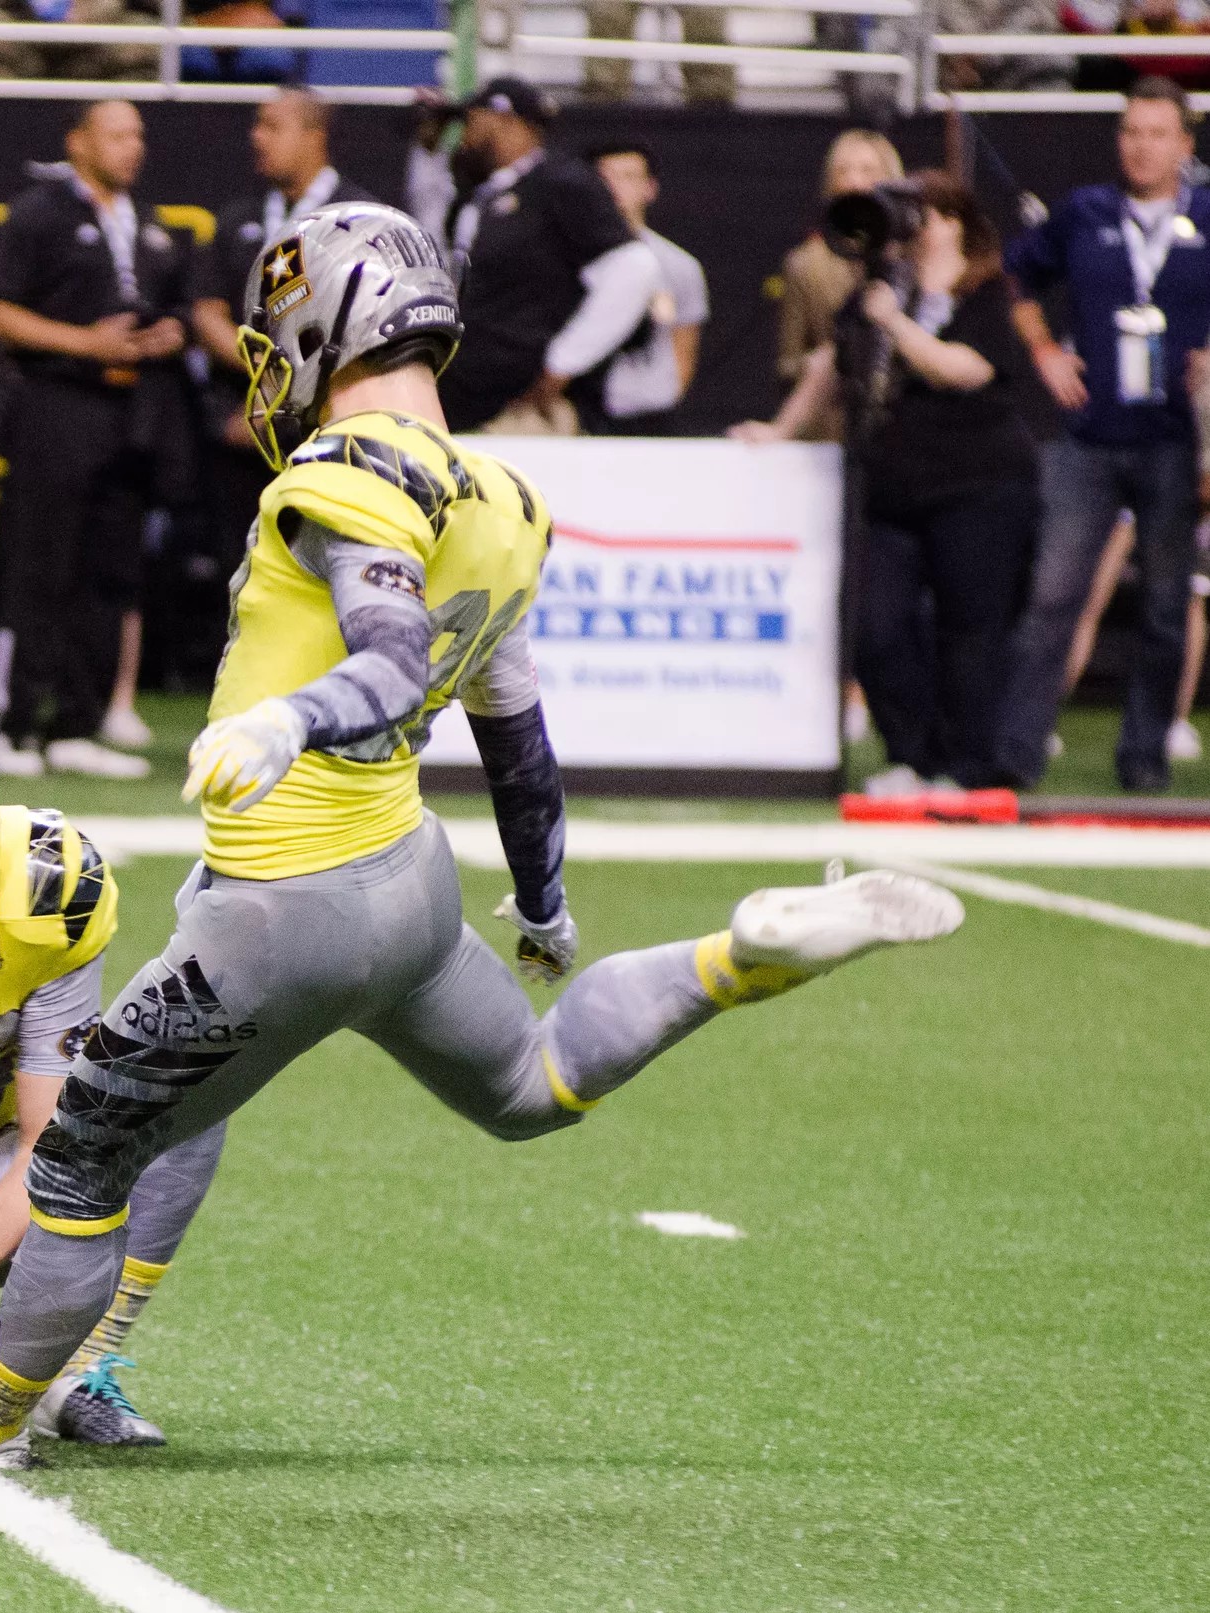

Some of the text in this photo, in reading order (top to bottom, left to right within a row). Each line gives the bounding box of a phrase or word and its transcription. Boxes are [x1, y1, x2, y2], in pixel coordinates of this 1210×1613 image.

[406, 304, 456, 325] XENITH
[542, 564, 790, 598] AN FAMILY
[121, 1001, 258, 1043] adidas
